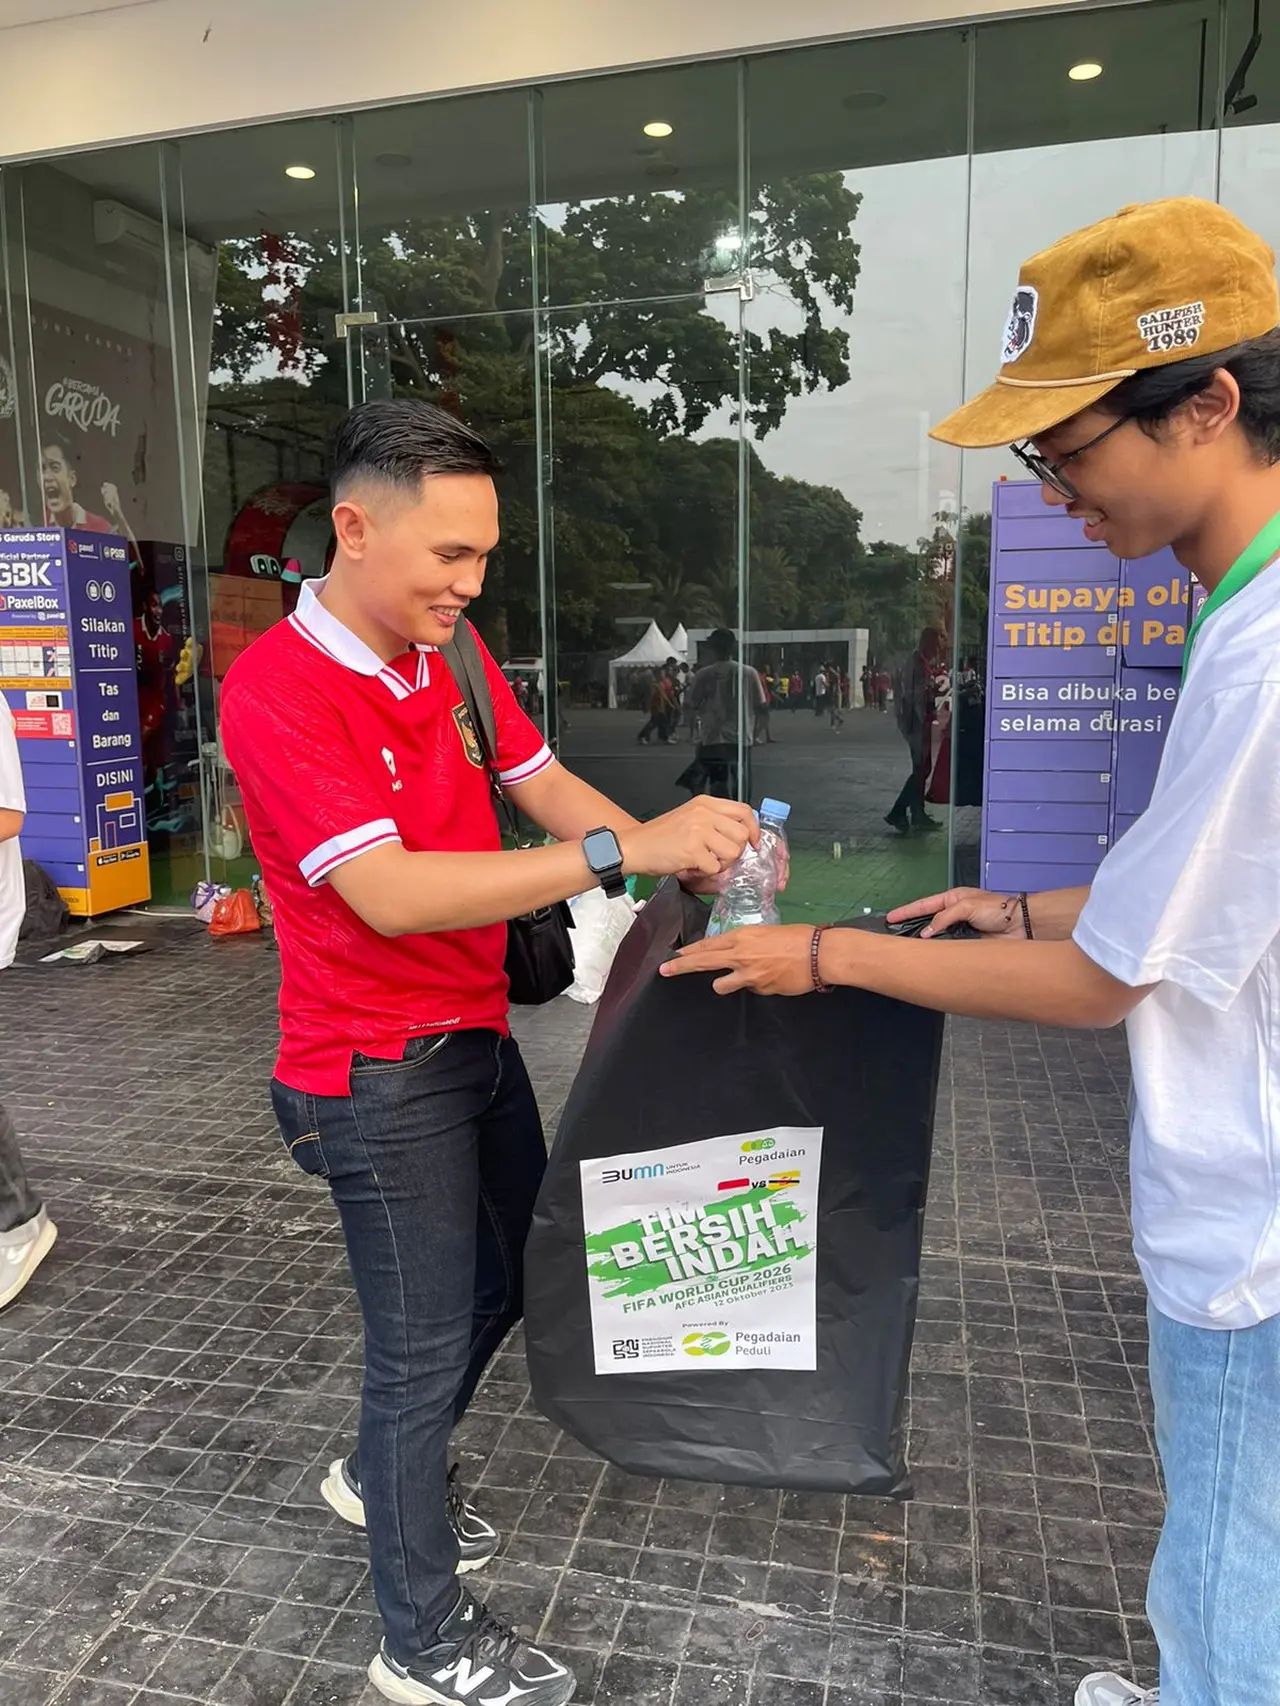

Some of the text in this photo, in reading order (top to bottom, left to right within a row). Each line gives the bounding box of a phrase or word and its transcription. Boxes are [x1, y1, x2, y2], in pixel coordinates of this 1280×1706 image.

[1140, 303, 1203, 327] SAILFISH
[1142, 314, 1202, 338] HUNTER
[1150, 327, 1198, 350] 1989
[3, 533, 35, 543] Garuda
[36, 532, 61, 542] Store
[20, 552, 51, 560] Partner
[0, 562, 52, 587] GBK
[7, 595, 59, 609] PaxelBox
[1004, 583, 1135, 613] Supaya
[81, 618, 126, 634] Silakan
[1003, 620, 1185, 651] Titip di Pa
[88, 644, 119, 661] Titip
[98, 682, 120, 697] Tas
[1002, 683, 1182, 702] Bisa dibuka be
[101, 710, 120, 722] dan
[1000, 713, 1162, 732] selama durasi
[92, 733, 132, 749] Barang
[96, 769, 134, 788] DISINI
[739, 1148, 806, 1165] Pegadaian
[633, 1204, 707, 1236] TIM
[611, 1199, 777, 1269] BERSIH
[666, 1218, 806, 1281] INDAH
[622, 1263, 792, 1314] FIFA WORLD CUP 2026
[675, 1274, 793, 1311] AFC ASIAN QUALIFIERS
[714, 1281, 795, 1308] 12 Oktober 2025
[681, 1321, 717, 1329] Powered
[735, 1331, 801, 1345] Pegadaian
[735, 1345, 771, 1356] Peduli
